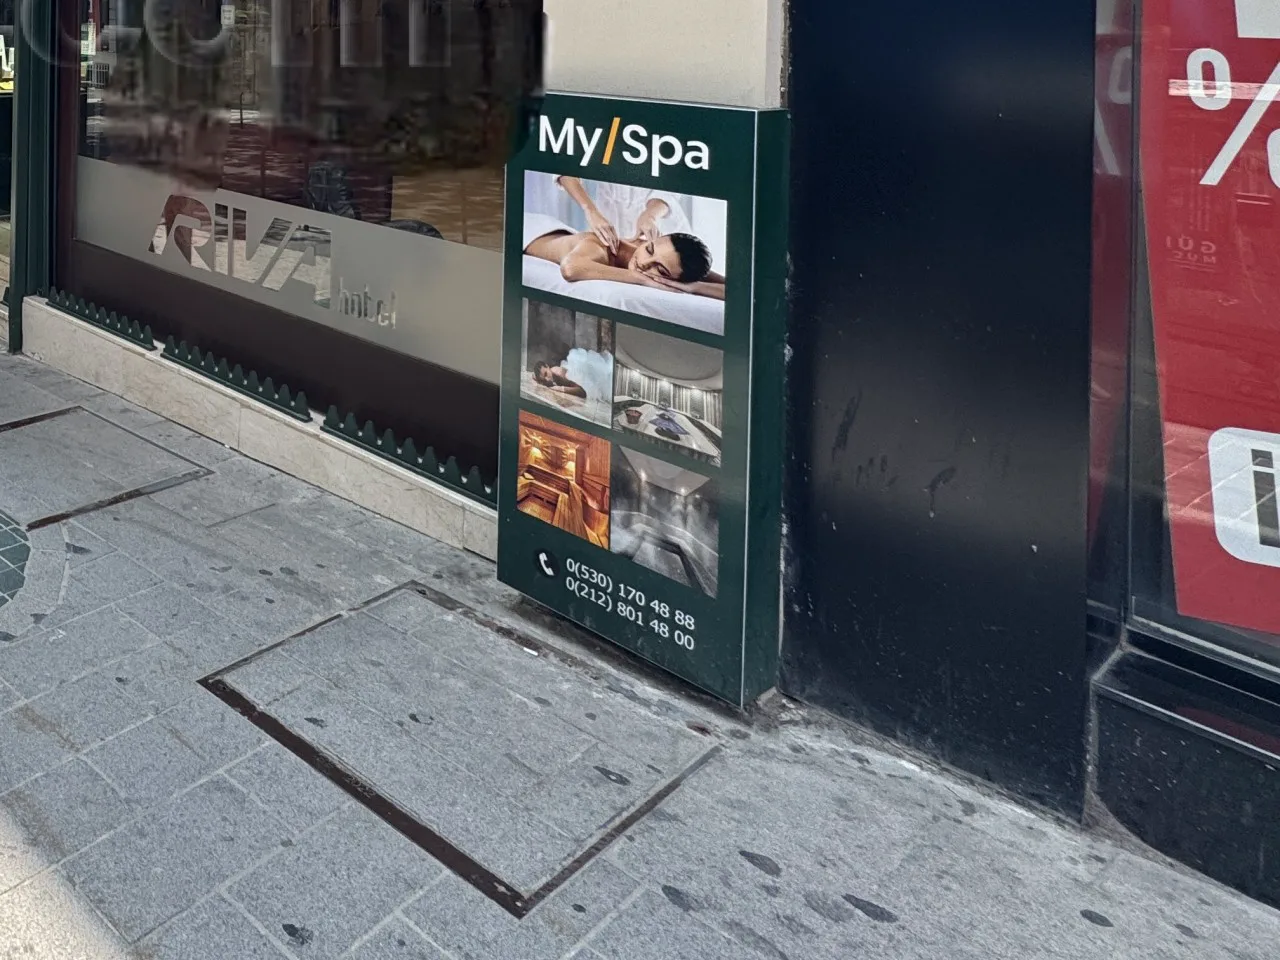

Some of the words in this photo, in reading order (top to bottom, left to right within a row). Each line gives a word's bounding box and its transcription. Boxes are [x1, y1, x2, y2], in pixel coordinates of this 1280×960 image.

[538, 114, 710, 178] My/Spa
[566, 558, 613, 593] 0(530)
[618, 583, 646, 606] 170
[650, 599, 670, 618] 48
[674, 610, 695, 631] 88
[566, 576, 613, 613] 0(212)
[617, 601, 644, 626] 801
[649, 618, 669, 638] 48
[674, 631, 695, 651] 00
